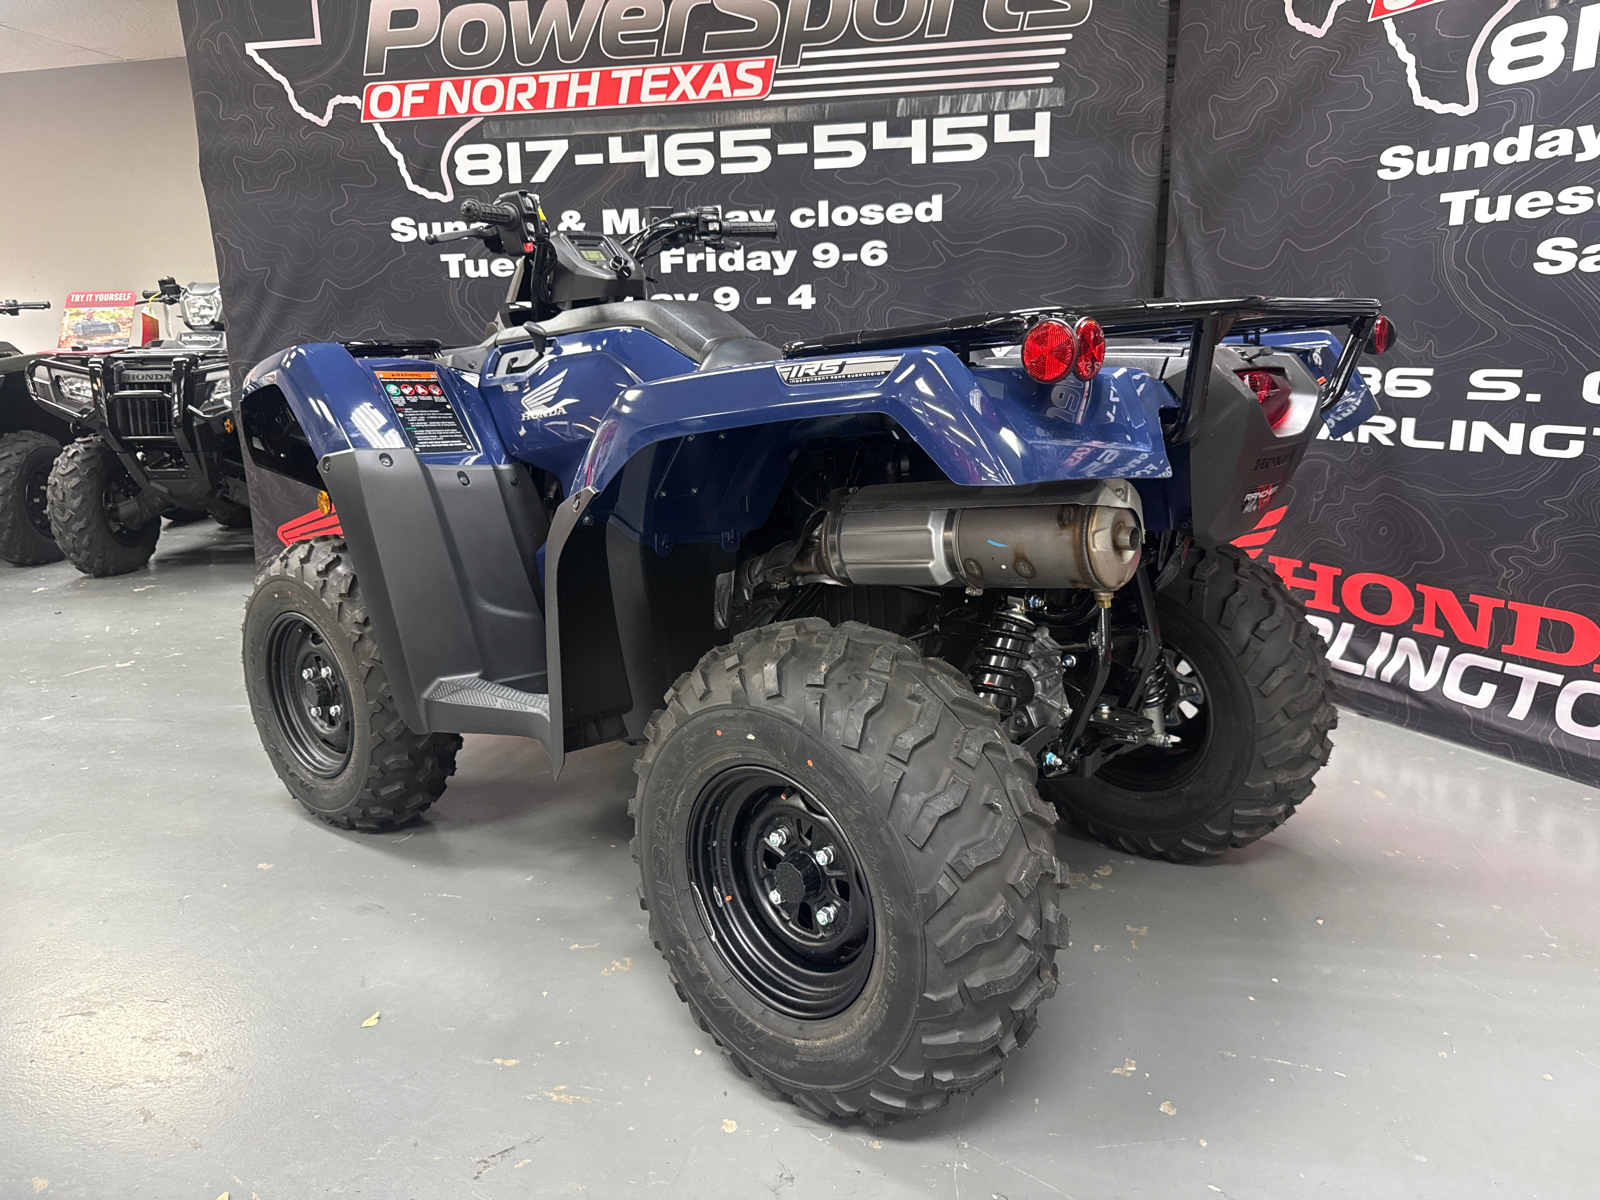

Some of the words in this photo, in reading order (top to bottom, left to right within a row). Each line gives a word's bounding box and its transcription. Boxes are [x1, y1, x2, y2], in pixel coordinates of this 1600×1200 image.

[369, 82, 430, 119] OF
[437, 69, 600, 115] NORTH
[611, 60, 766, 105] TEXAS
[453, 111, 1052, 186] 817-465-5454
[557, 209, 586, 232] &
[789, 193, 944, 230] closed
[1439, 185, 1600, 226] Tues
[659, 246, 798, 276] Friday
[811, 240, 889, 270] 9-6
[71, 294, 86, 303] TRY
[86, 294, 94, 302] IT
[94, 292, 132, 302] YOURSELF
[712, 285, 741, 312] 9
[787, 283, 817, 310] 4
[127, 373, 171, 381] HONDA
[789, 363, 840, 378] IRS
[1467, 368, 1542, 403] S.
[520, 407, 568, 421] HONDA
[1316, 414, 1600, 459] RLING
[1268, 555, 1600, 675] HOND
